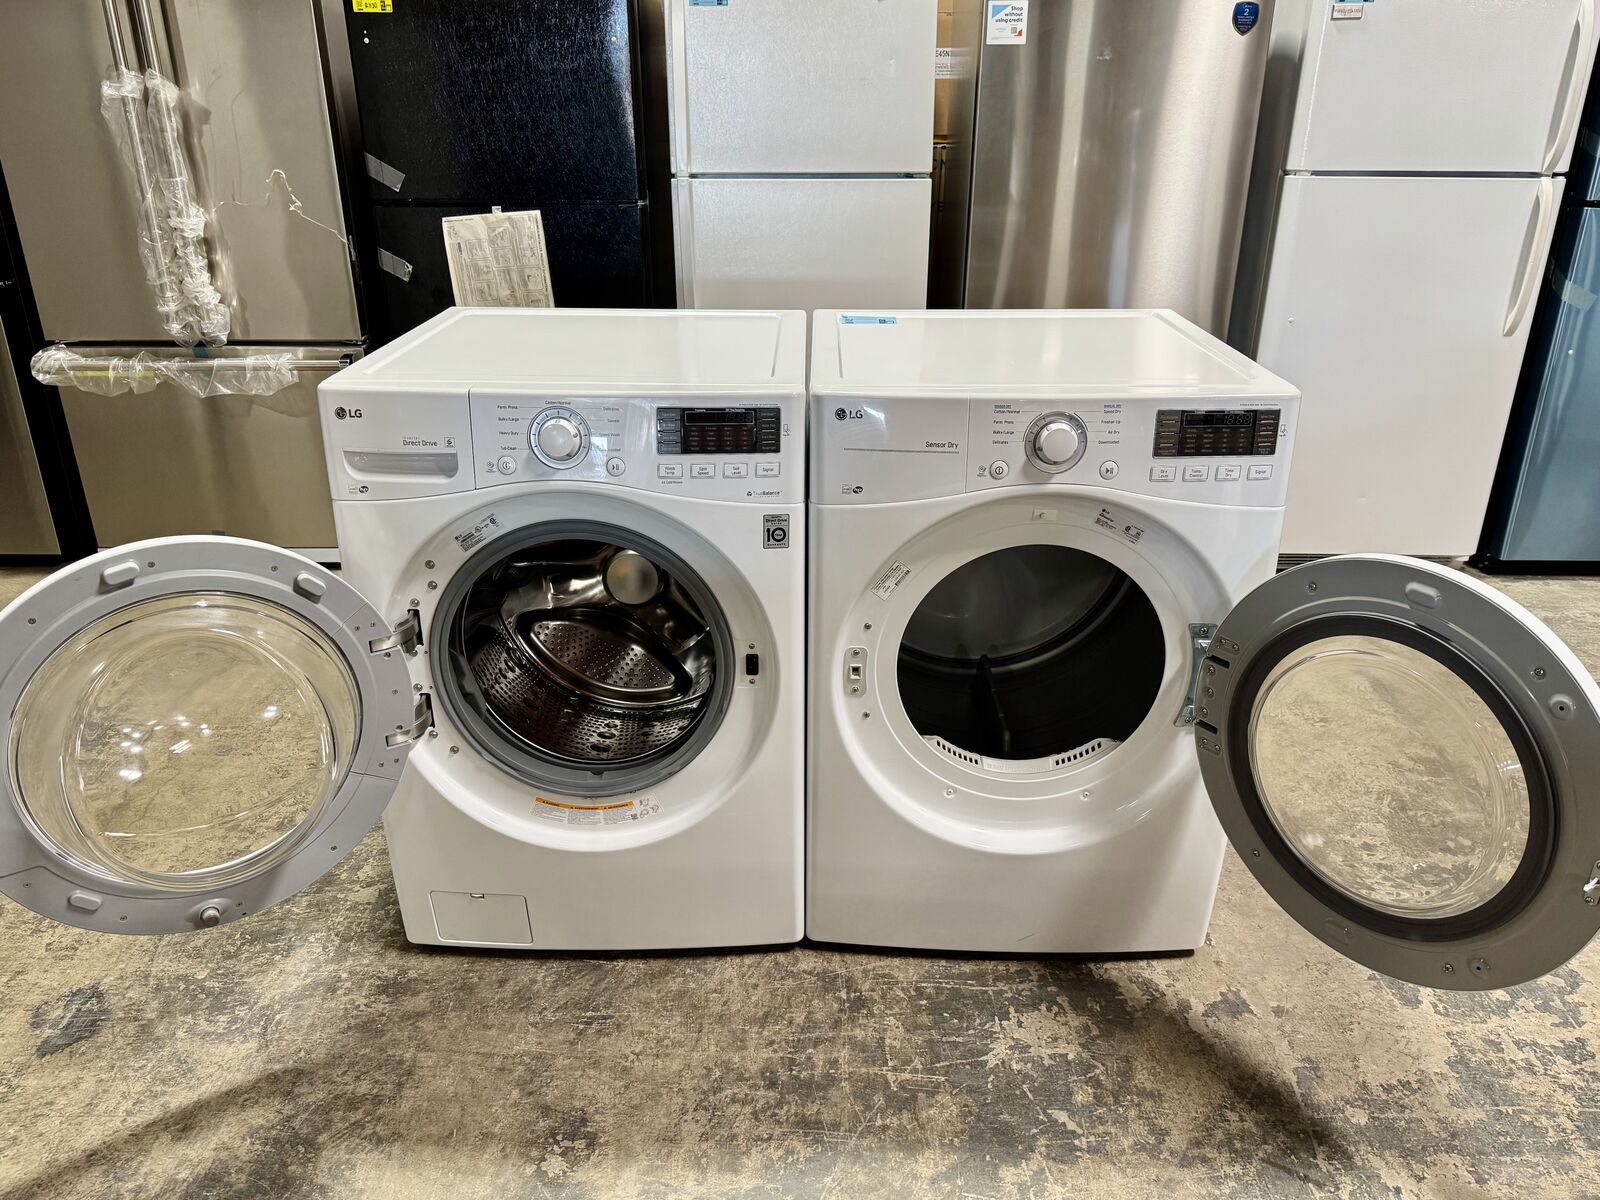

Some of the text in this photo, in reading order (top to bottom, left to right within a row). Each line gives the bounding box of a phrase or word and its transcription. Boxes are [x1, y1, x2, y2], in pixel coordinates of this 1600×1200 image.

[348, 409, 362, 418] LG
[849, 410, 863, 419] LG
[766, 527, 786, 542] 10
